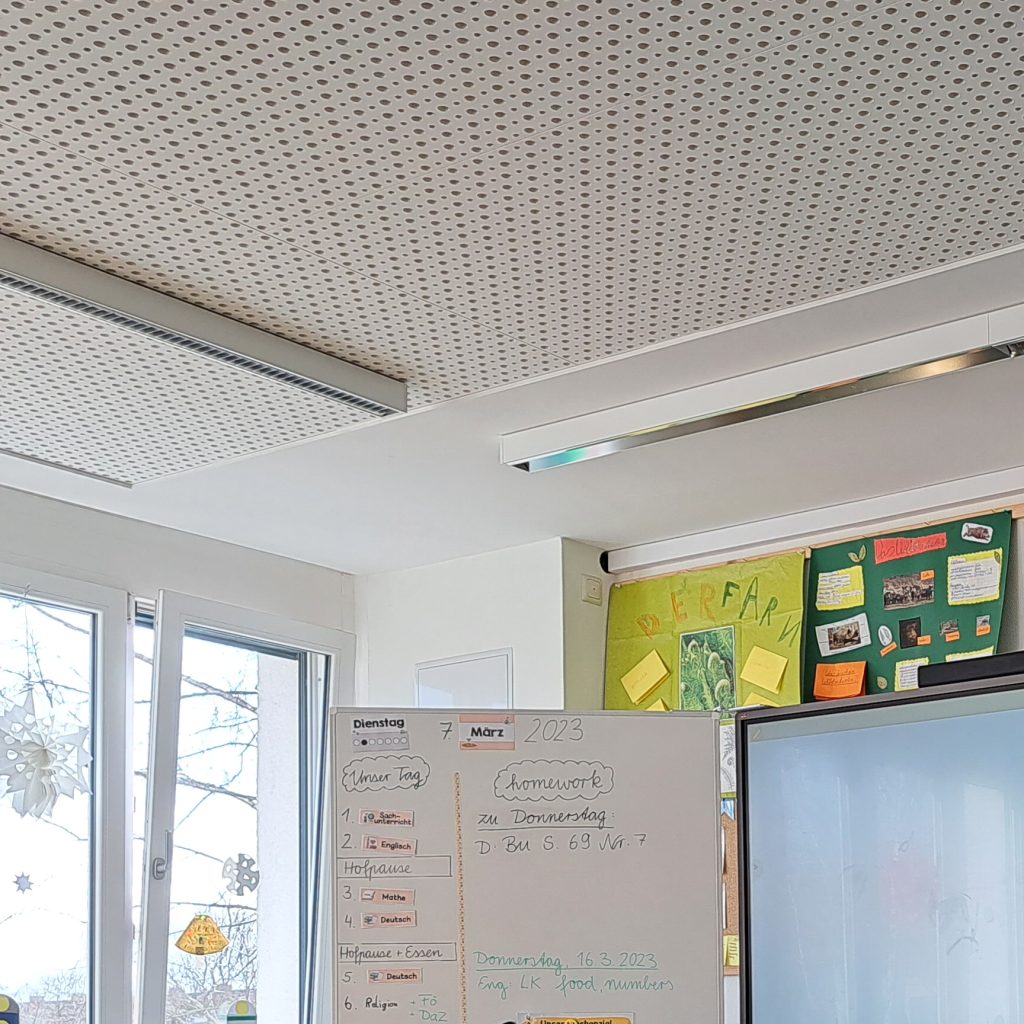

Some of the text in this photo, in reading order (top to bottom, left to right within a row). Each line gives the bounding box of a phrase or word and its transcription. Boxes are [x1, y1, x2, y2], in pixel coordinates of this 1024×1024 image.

[353, 718, 405, 730] Dienstag
[470, 725, 505, 738] März
[524, 718, 584, 743] 2023
[349, 766, 424, 791] Unser Tag
[505, 769, 604, 792] homework
[341, 808, 355, 824] 1.
[373, 818, 412, 826] unterricht
[478, 813, 499, 826] zu
[341, 833, 358, 850] 2.
[380, 840, 412, 851] Englisch
[543, 834, 559, 851] S.
[569, 832, 592, 851] 69
[599, 833, 631, 851] Nr.
[633, 833, 648, 847] 7
[344, 859, 413, 881] Hofpause
[382, 893, 406, 902] Mathe
[380, 916, 412, 924] Deutsch
[339, 945, 392, 966] Hofpause
[404, 945, 443, 959] Essen
[386, 972, 418, 980] Deutsch
[520, 974, 542, 990] LK
[604, 975, 675, 992] numbers
[344, 995, 358, 1011] 6.
[418, 1009, 448, 1022] DaZ
